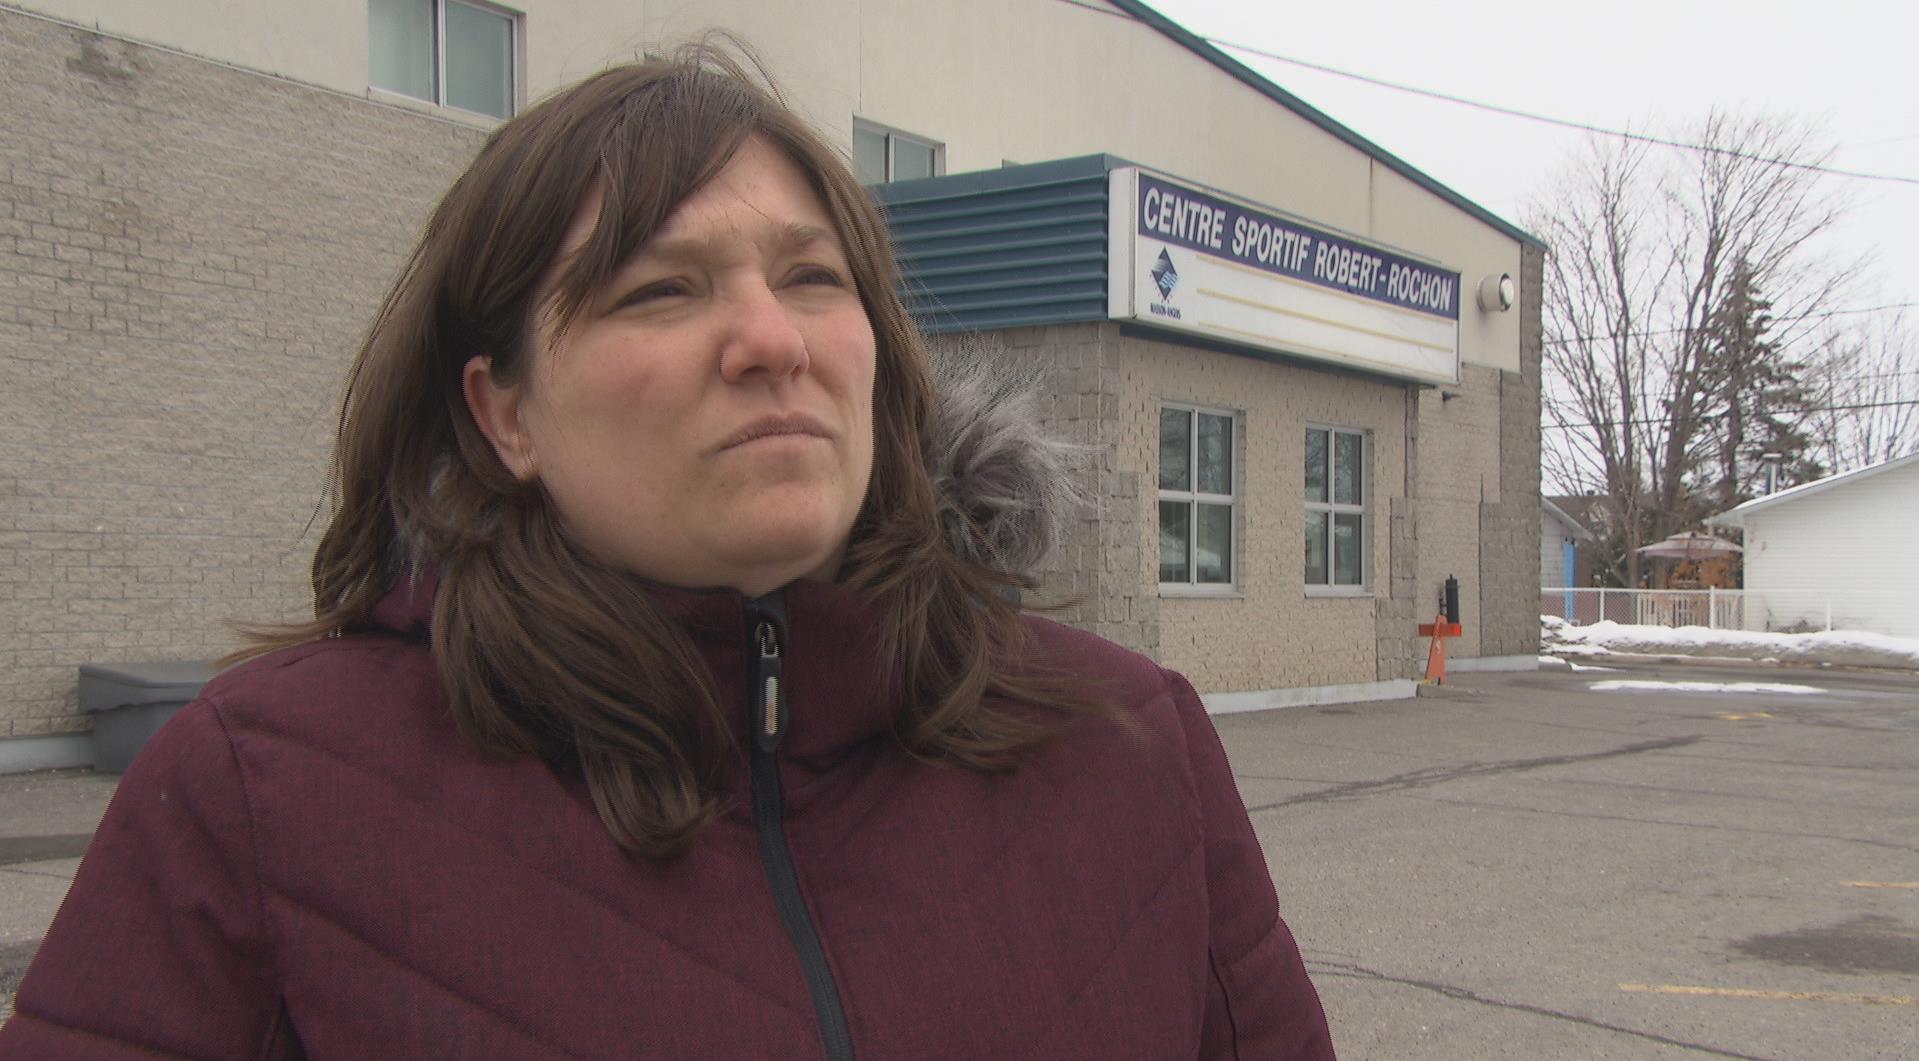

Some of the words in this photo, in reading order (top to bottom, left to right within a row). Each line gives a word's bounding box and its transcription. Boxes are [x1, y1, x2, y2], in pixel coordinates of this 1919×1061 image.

[1144, 187, 1226, 249] CENTRE
[1232, 216, 1311, 272] SPORTIF
[1314, 241, 1452, 311] ROBERT-ROCHON
